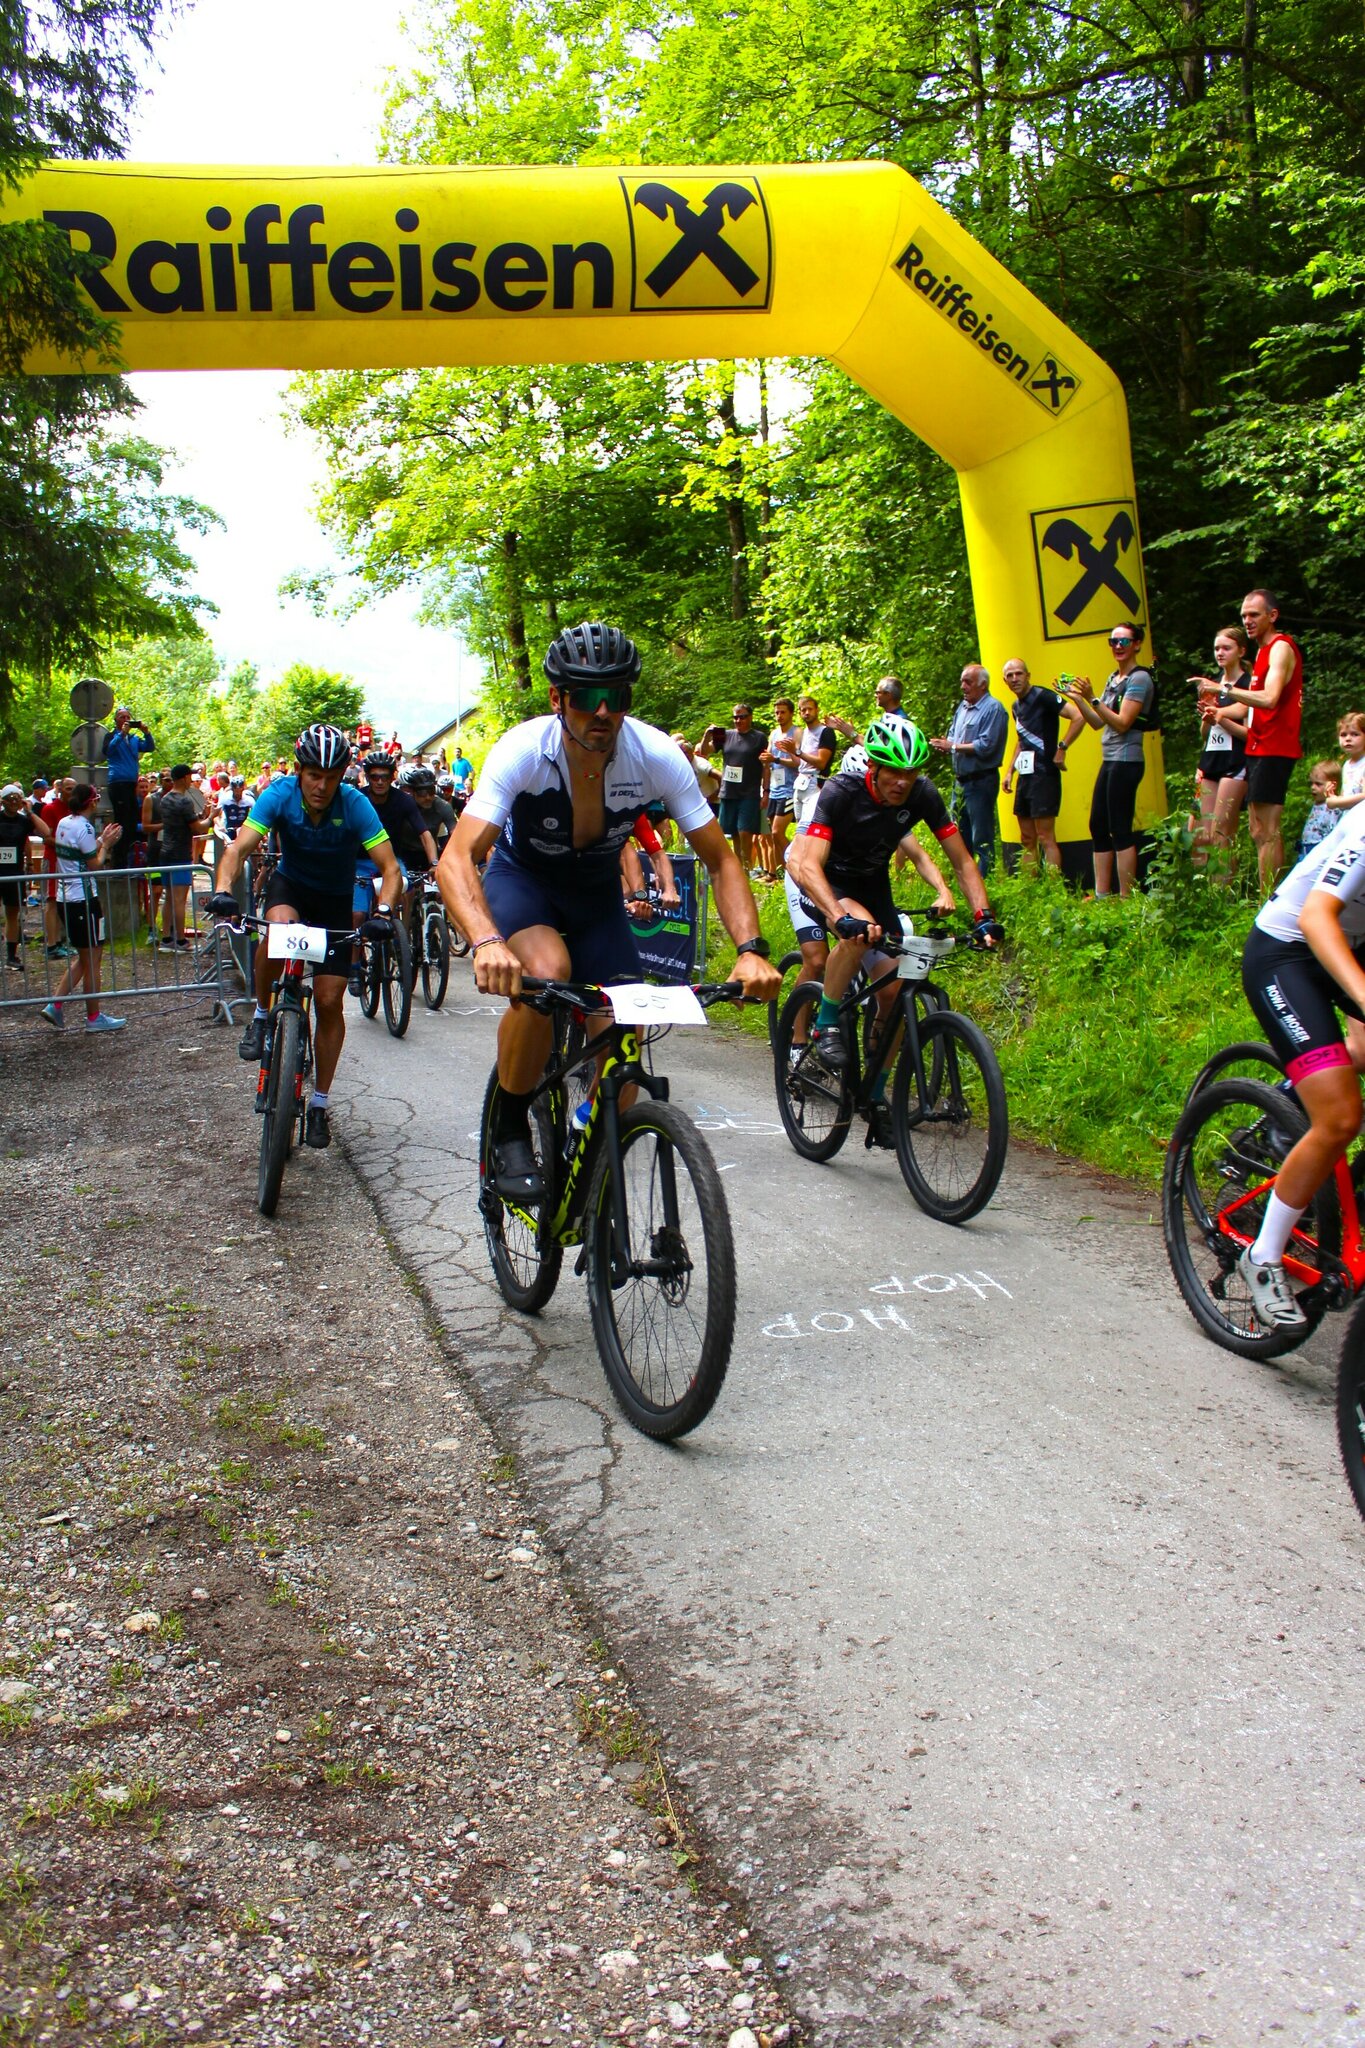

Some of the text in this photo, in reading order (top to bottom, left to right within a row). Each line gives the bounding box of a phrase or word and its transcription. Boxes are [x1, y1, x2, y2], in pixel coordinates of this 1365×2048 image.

[43, 204, 613, 313] Raiffeisen
[895, 242, 1030, 381] Raiffeisen
[286, 936, 309, 951] 86
[1265, 984, 1287, 1011] ROWA
[1283, 1014, 1312, 1043] MOSER
[868, 1270, 1013, 1301] HOP
[761, 1304, 914, 1338] HOP
